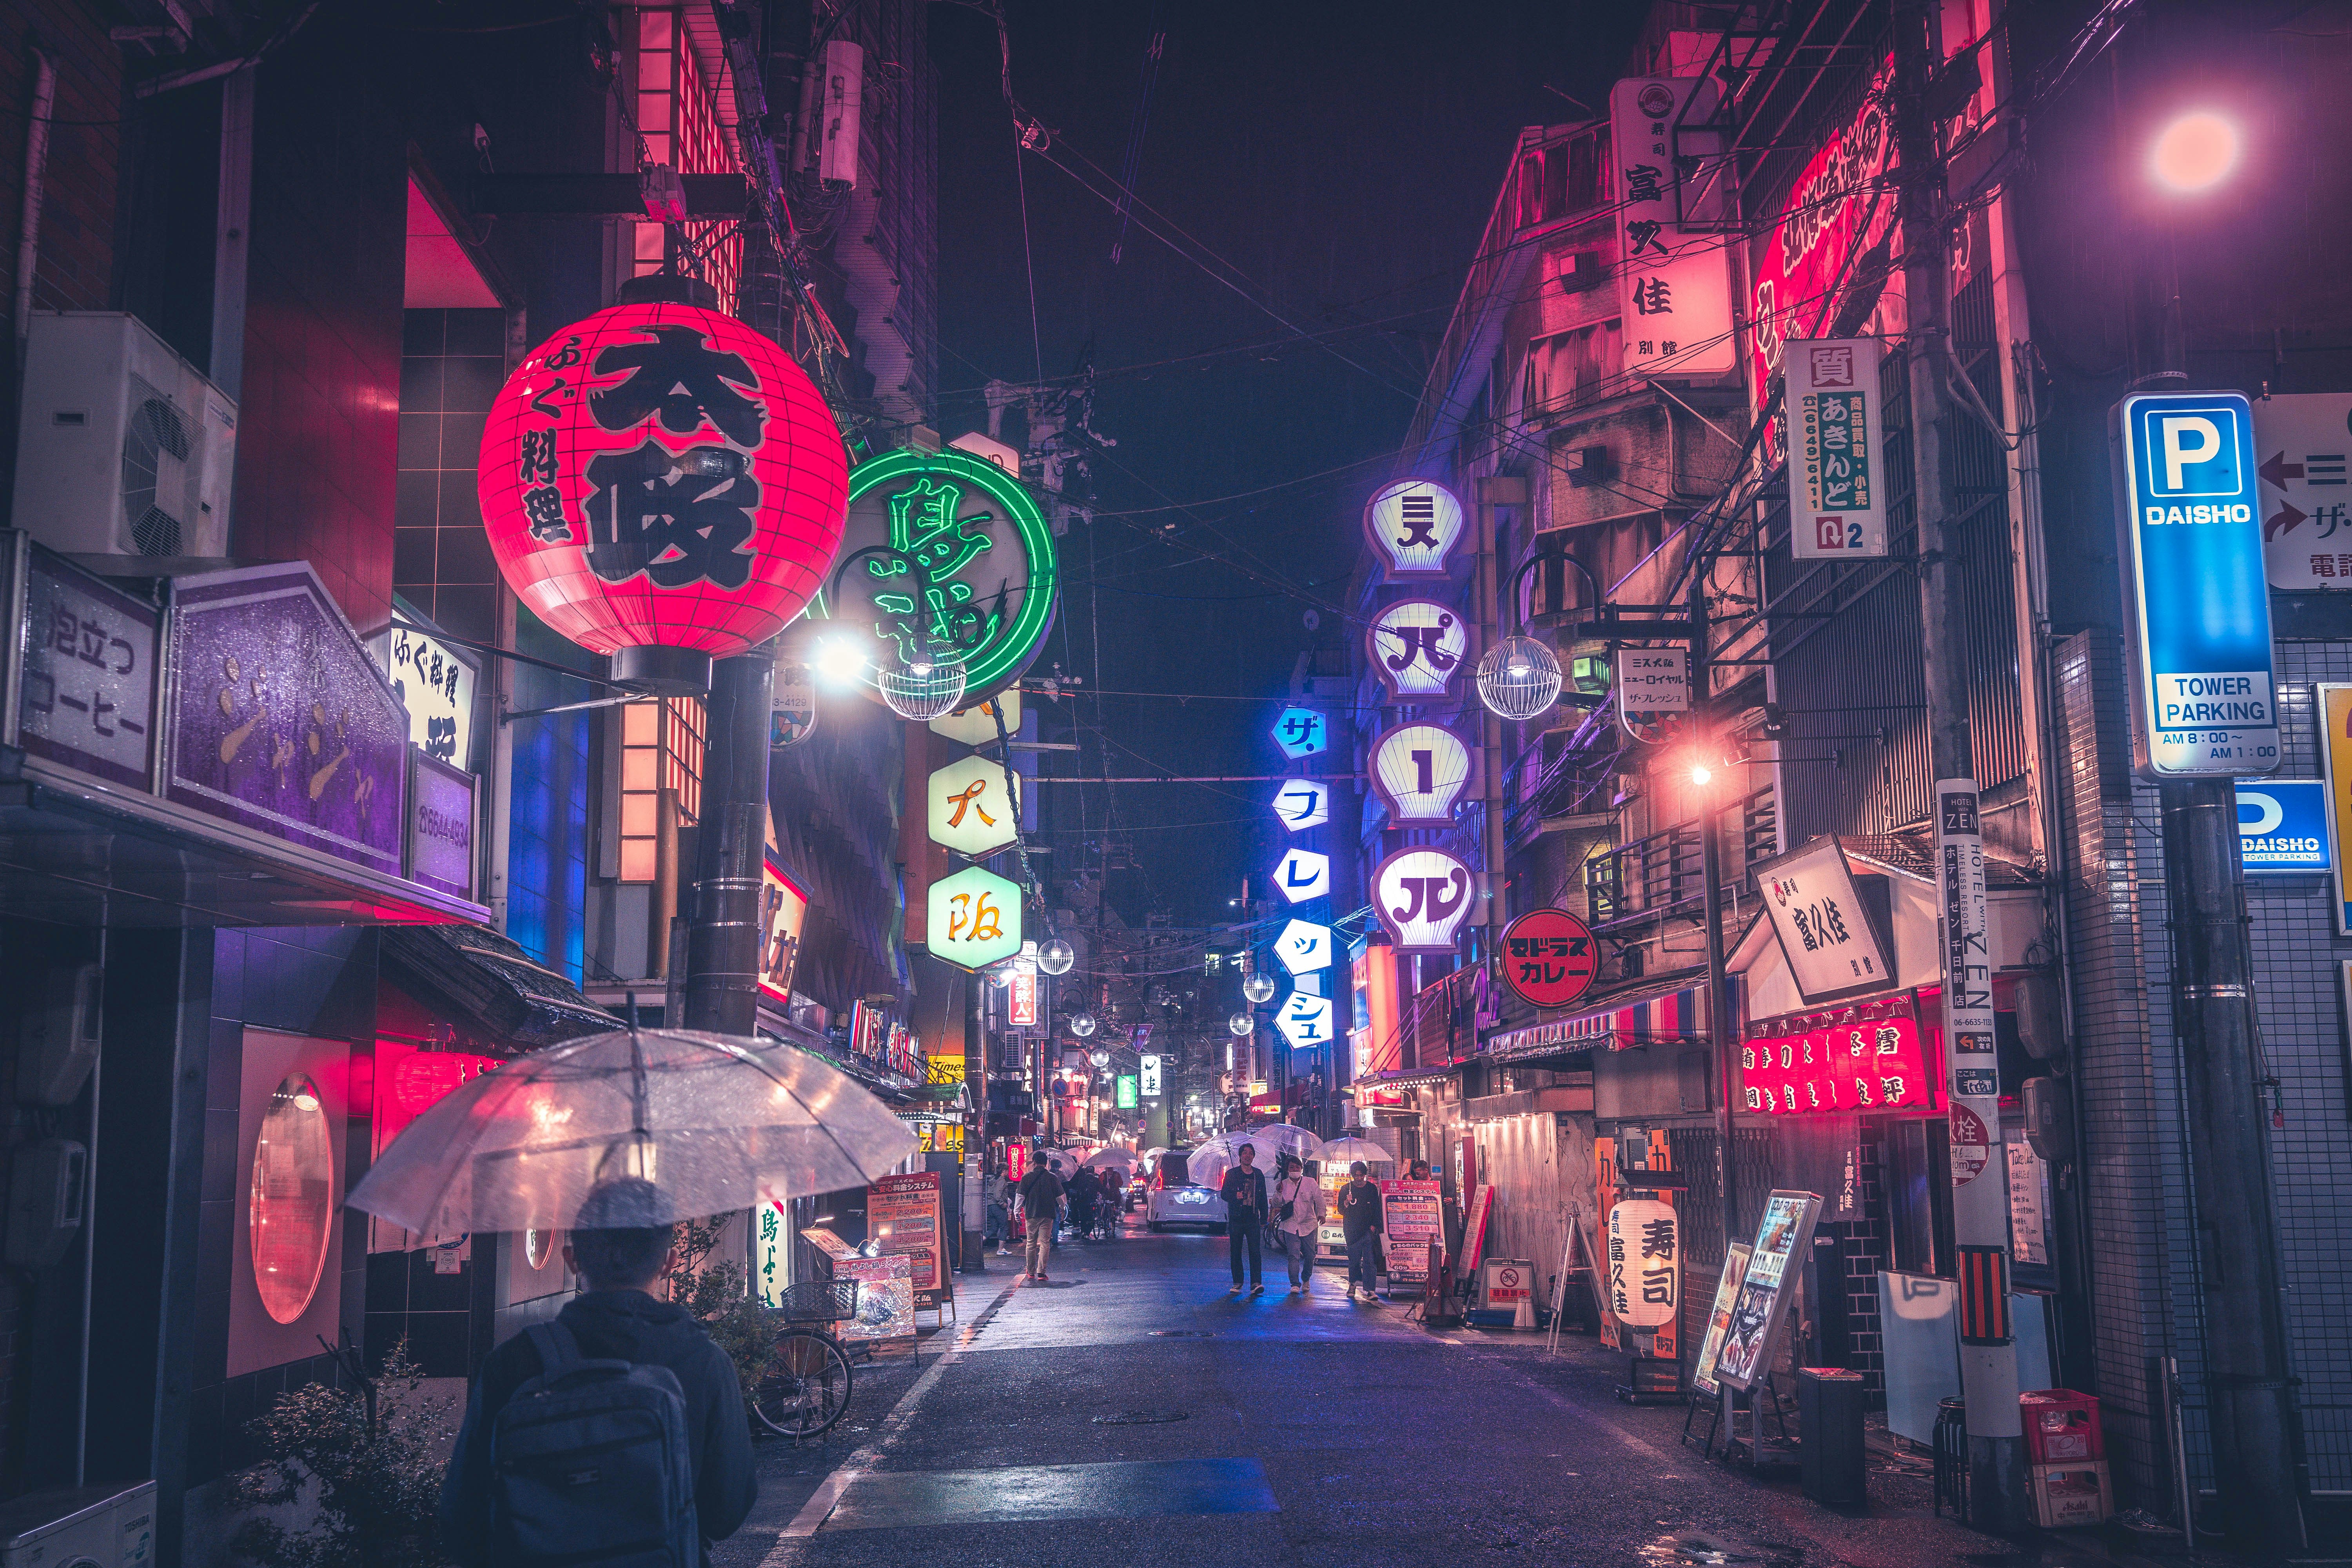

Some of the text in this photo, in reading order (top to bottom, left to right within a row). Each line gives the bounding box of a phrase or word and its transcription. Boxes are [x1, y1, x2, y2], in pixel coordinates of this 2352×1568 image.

[1651, 122, 1665, 156] 寿司
[1639, 340, 1677, 355] 別館
[1812, 348, 1852, 385] 質
[1822, 397, 1851, 507] あきんど
[2162, 417, 2220, 489] P
[2146, 504, 2250, 525] DAISHO
[1847, 523, 1863, 548] 2
[1624, 675, 1684, 685] ニューロイヤル
[2174, 677, 2251, 696] TOWER
[28, 670, 145, 737] コーヒー
[773, 698, 806, 707] 3-4129
[1629, 693, 1682, 703] ザ・フレッシュ
[2167, 701, 2265, 722] PARKING
[2163, 732, 2184, 744] AM
[2210, 746, 2232, 759] AM
[1946, 814, 1977, 829] ZEN
[2241, 838, 2319, 851] DAISHO
[1971, 844, 1984, 903] HOTEL
[1782, 878, 1799, 897] 寿司
[1961, 895, 1969, 931] RESORT
[1792, 896, 1851, 953] 富久佳
[1510, 937, 1589, 958] マドラス
[1520, 962, 1589, 984] カレー
[1851, 955, 1874, 977] 別館
[1962, 936, 1991, 1009] ZEN
[872, 1182, 935, 1194] ご安心料金システム
[886, 1193, 920, 1201] セット料金
[851, 1262, 879, 1271] 鳥よし鍋
[1642, 1218, 1675, 1308] 寿司
[1610, 1237, 1630, 1314] 富久佳
[2063, 1500, 2088, 1511] Asahi
[124, 1514, 149, 1533] TOSHIBA
